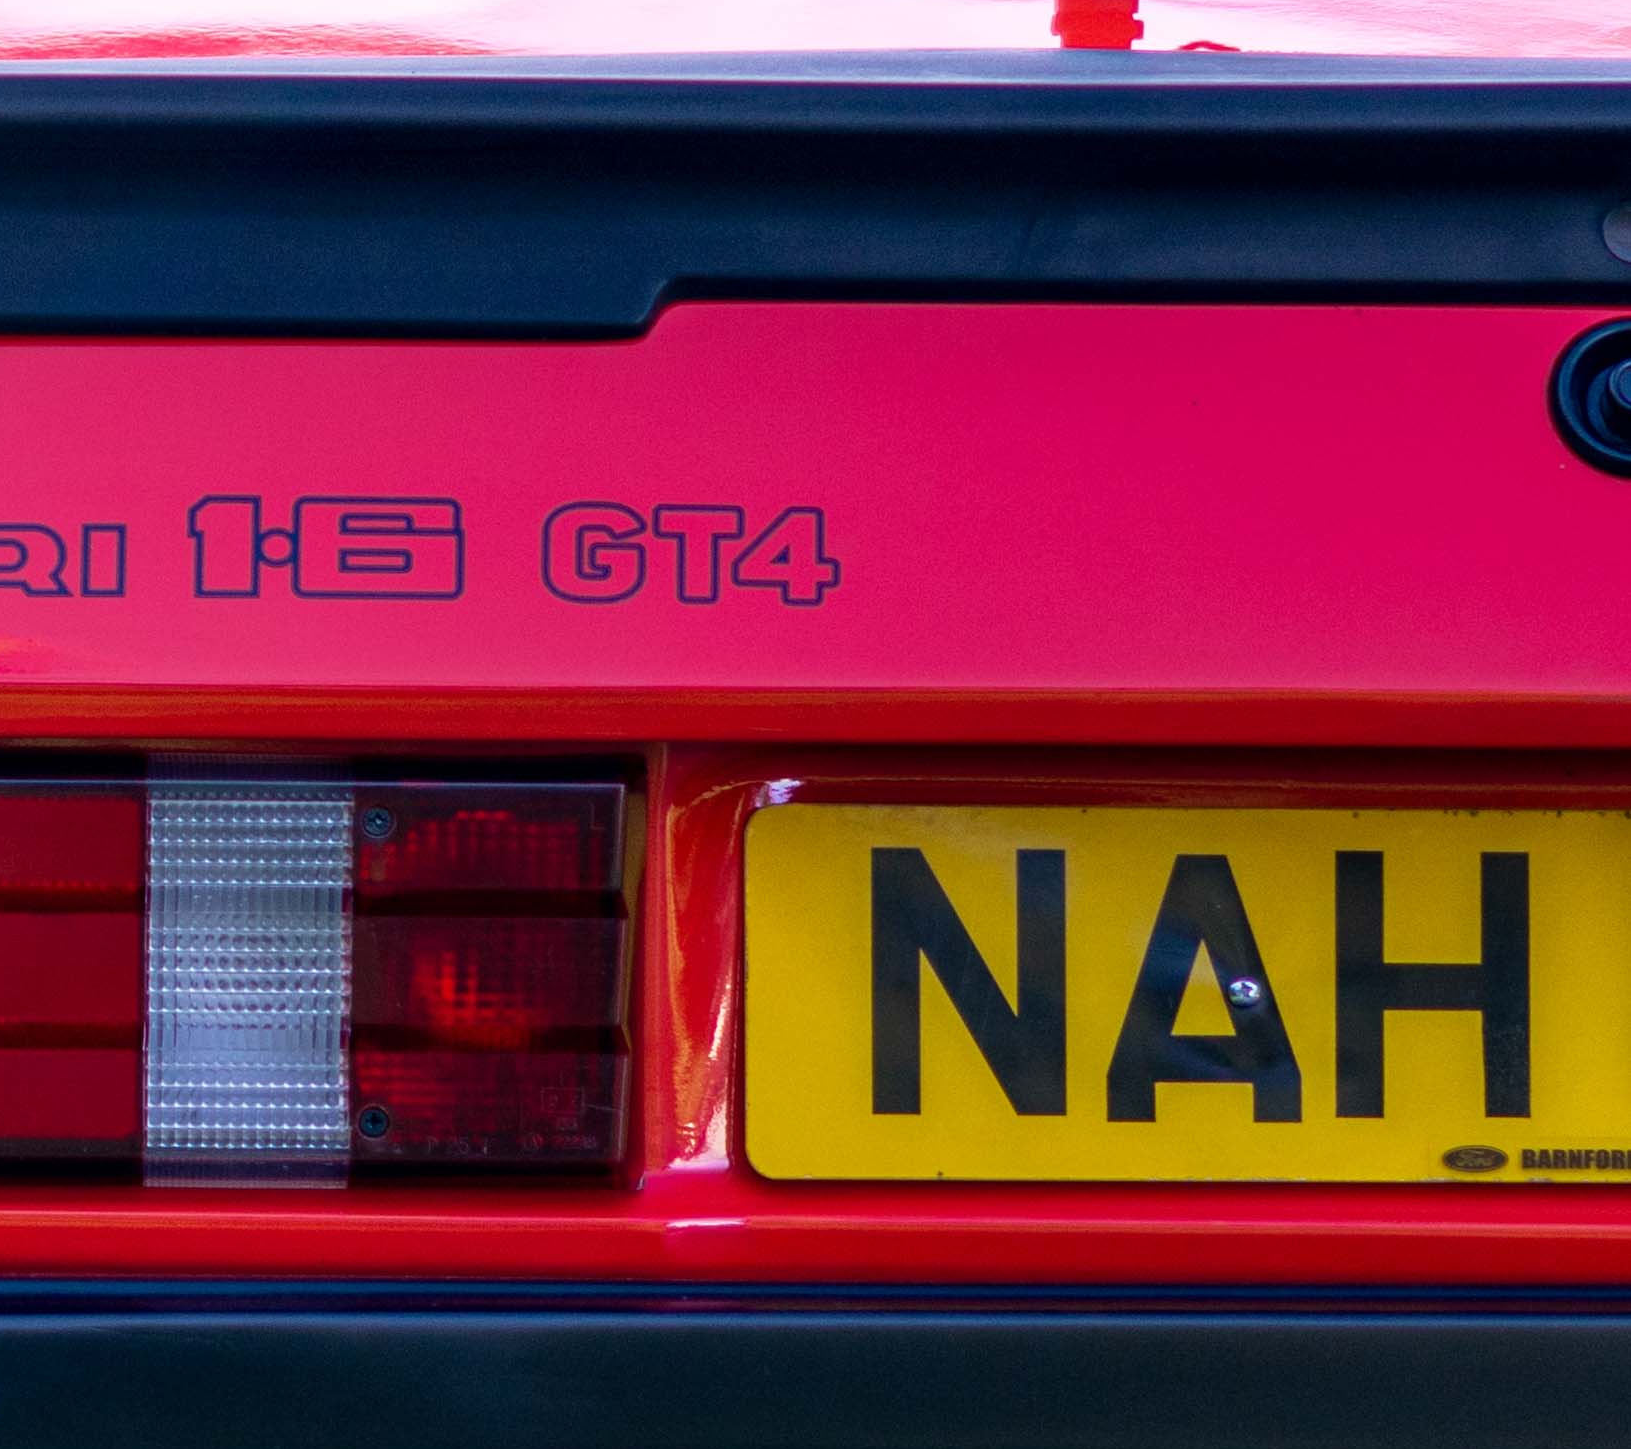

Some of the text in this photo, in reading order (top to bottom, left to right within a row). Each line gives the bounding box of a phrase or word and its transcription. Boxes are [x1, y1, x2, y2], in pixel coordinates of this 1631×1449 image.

[540, 501, 841, 607] GT4
[871, 846, 1532, 1123] NAH
[1521, 1149, 1631, 1170] BARNFOR
